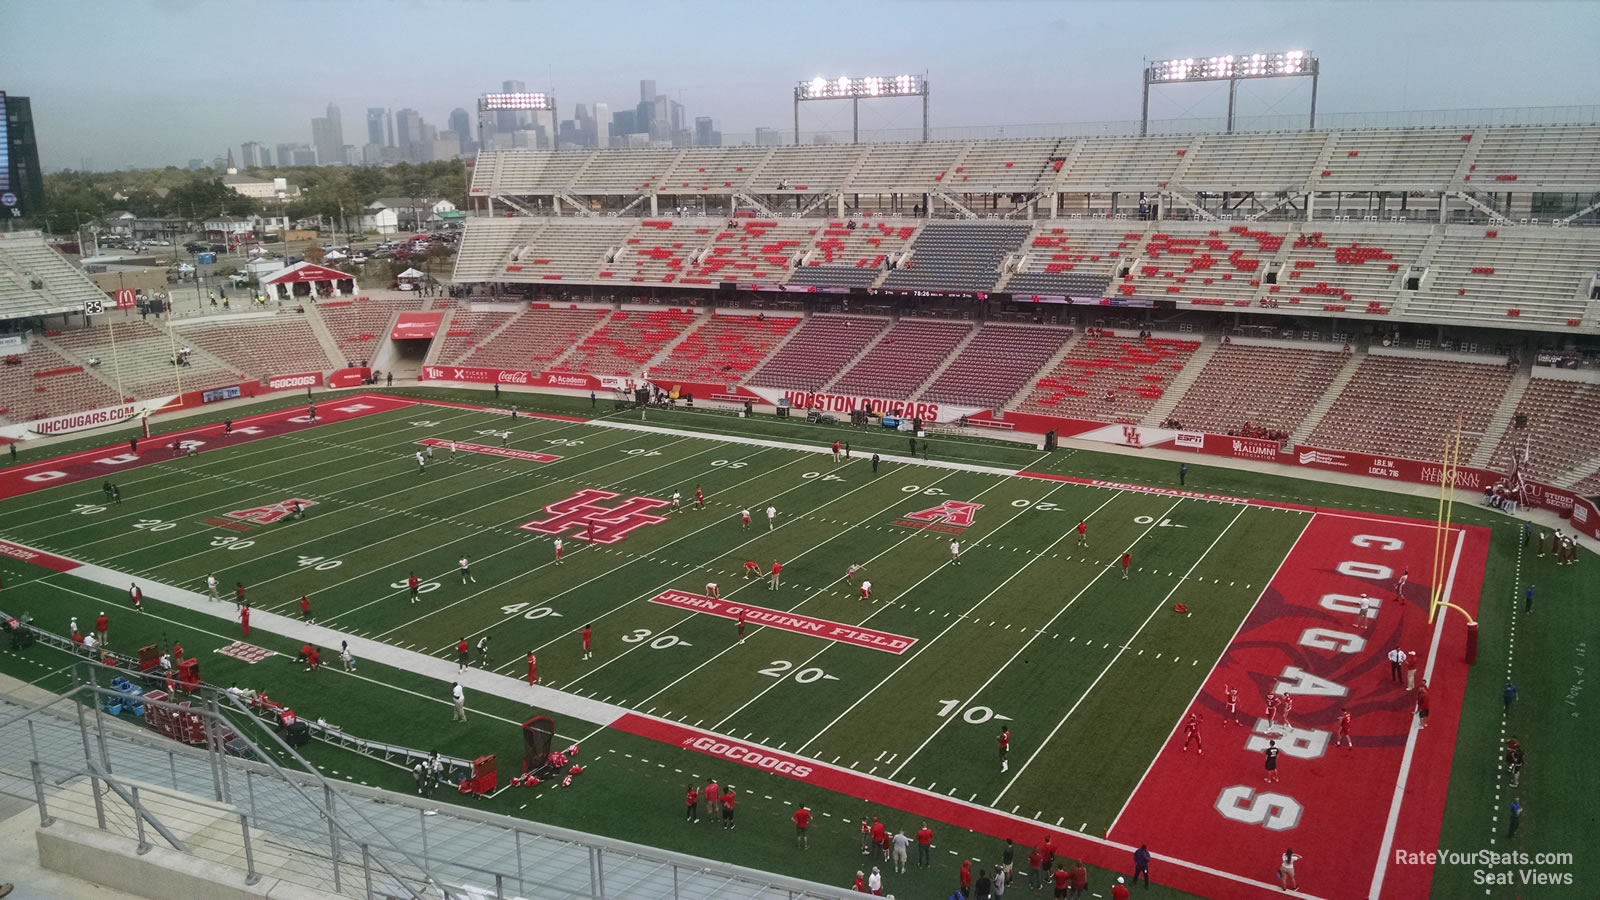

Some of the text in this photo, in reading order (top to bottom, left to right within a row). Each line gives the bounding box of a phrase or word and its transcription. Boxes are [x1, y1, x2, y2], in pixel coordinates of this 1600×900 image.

[88, 301, 102, 313] 25
[269, 376, 316, 389] #GOCOOGS
[36, 406, 135, 434] UHCOUGARS.COM
[1177, 433, 1203, 443] ESPN
[1242, 445, 1277, 457] ALUMNI
[1368, 466, 1388, 476] LOCAL
[500, 602, 553, 620] 40
[658, 593, 909, 651] JOHN O'QUINN FIELD
[622, 628, 681, 650] 30
[758, 660, 825, 684] 20
[936, 699, 994, 725] 10
